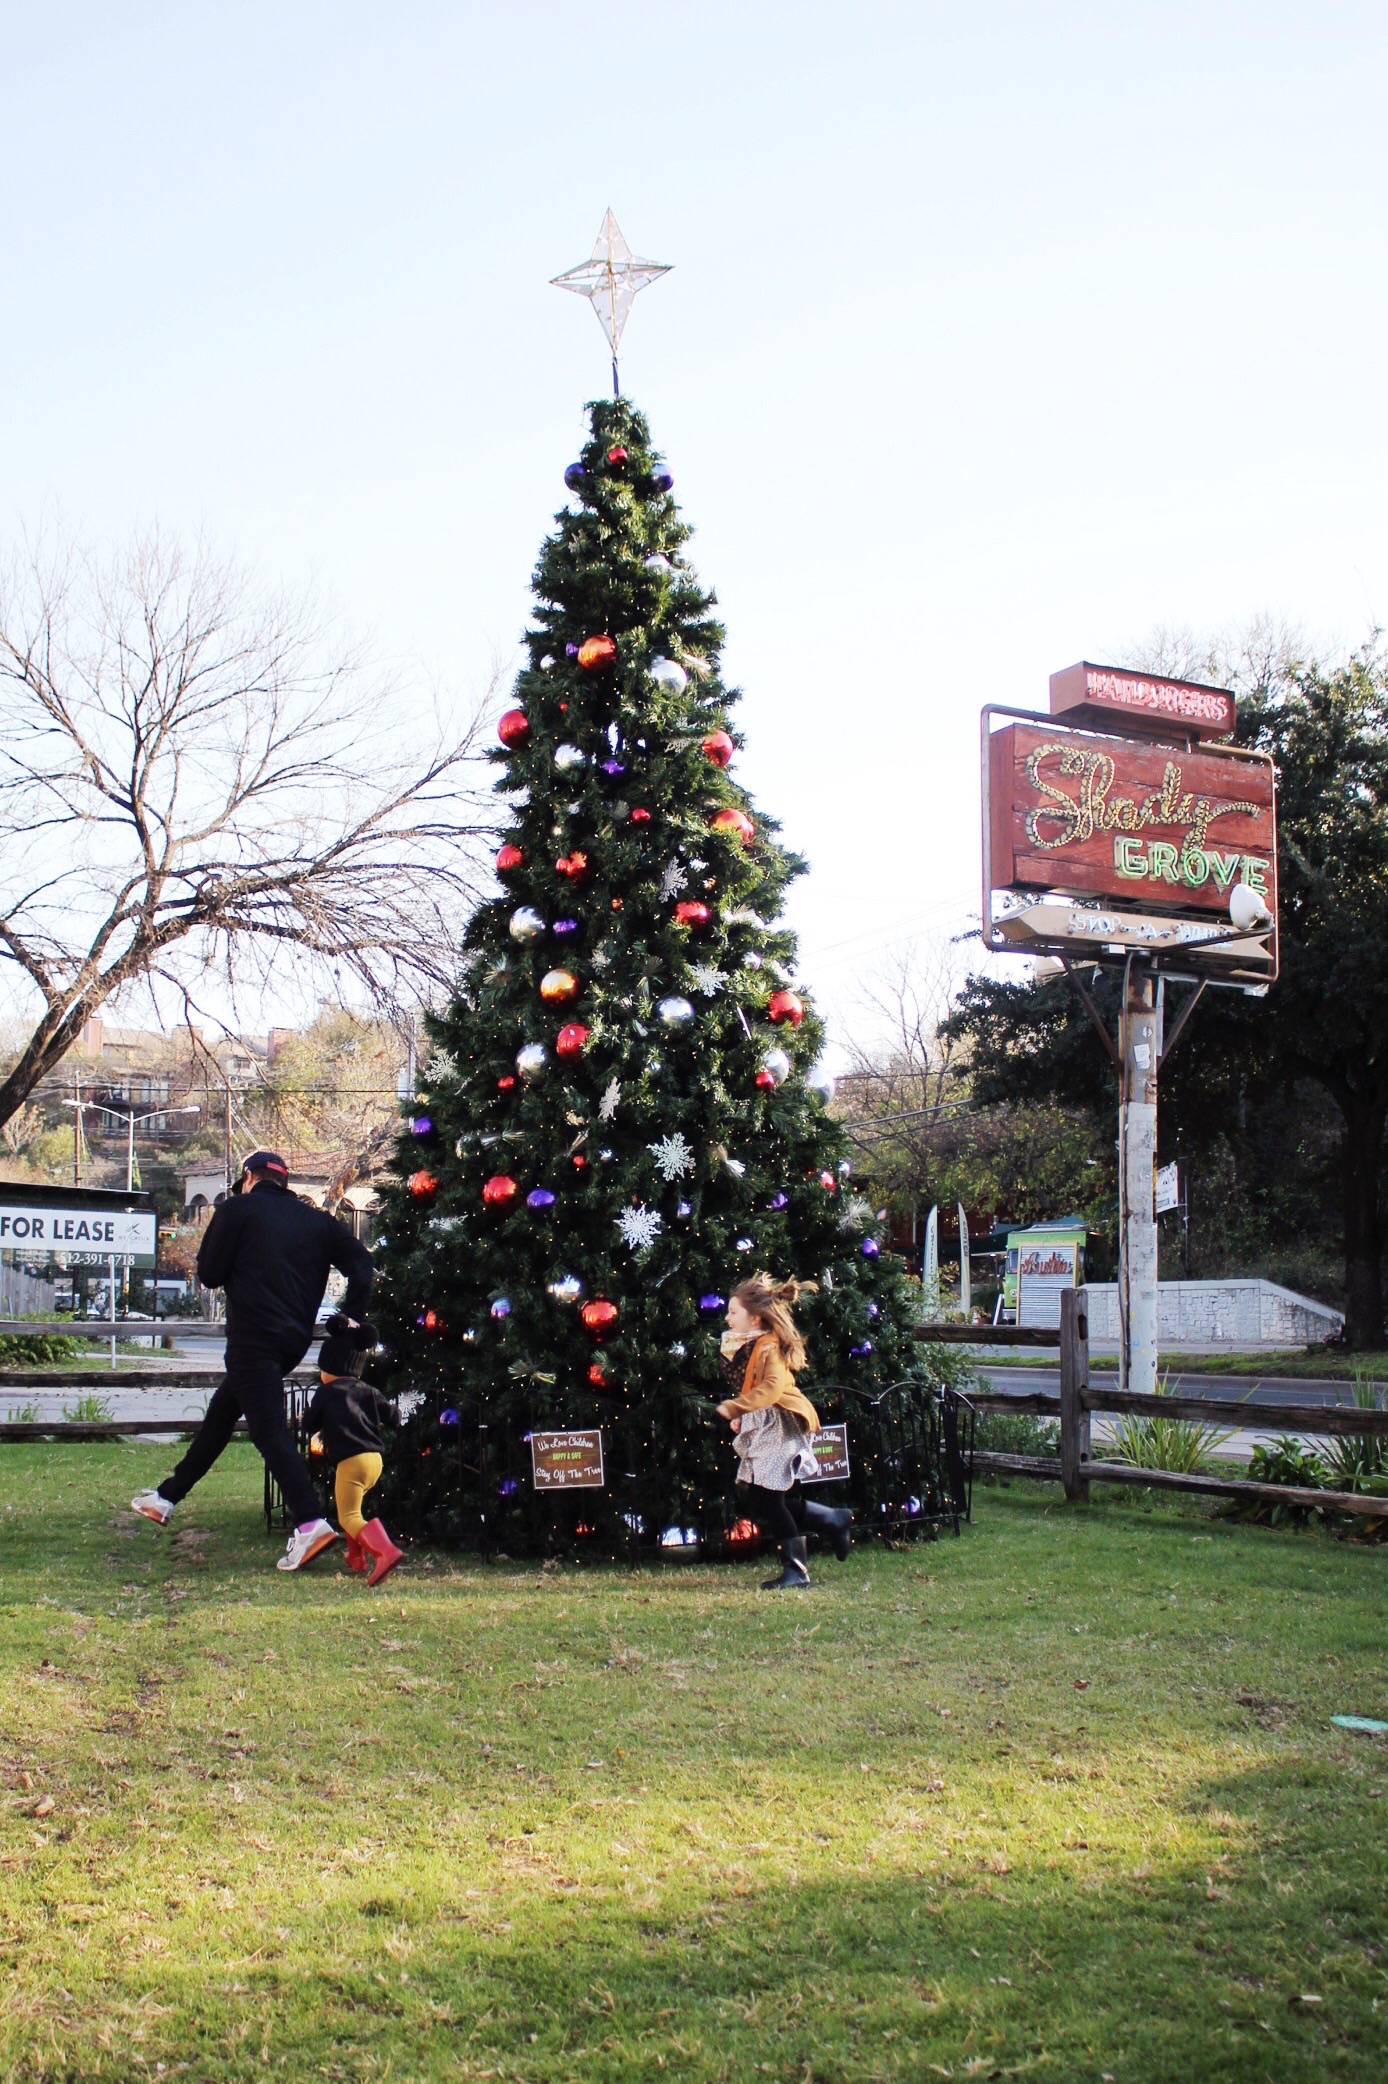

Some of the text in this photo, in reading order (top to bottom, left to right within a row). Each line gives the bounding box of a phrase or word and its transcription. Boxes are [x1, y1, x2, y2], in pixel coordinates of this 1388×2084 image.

[1087, 672, 1228, 721] HAMBURGERS
[1025, 743, 1261, 856] Shady
[1114, 836, 1270, 896] GROVE
[1, 1216, 115, 1242] FOR LEASE
[538, 1436, 594, 1452] We Love Children
[535, 1466, 601, 1483] Stay Off The Tree
